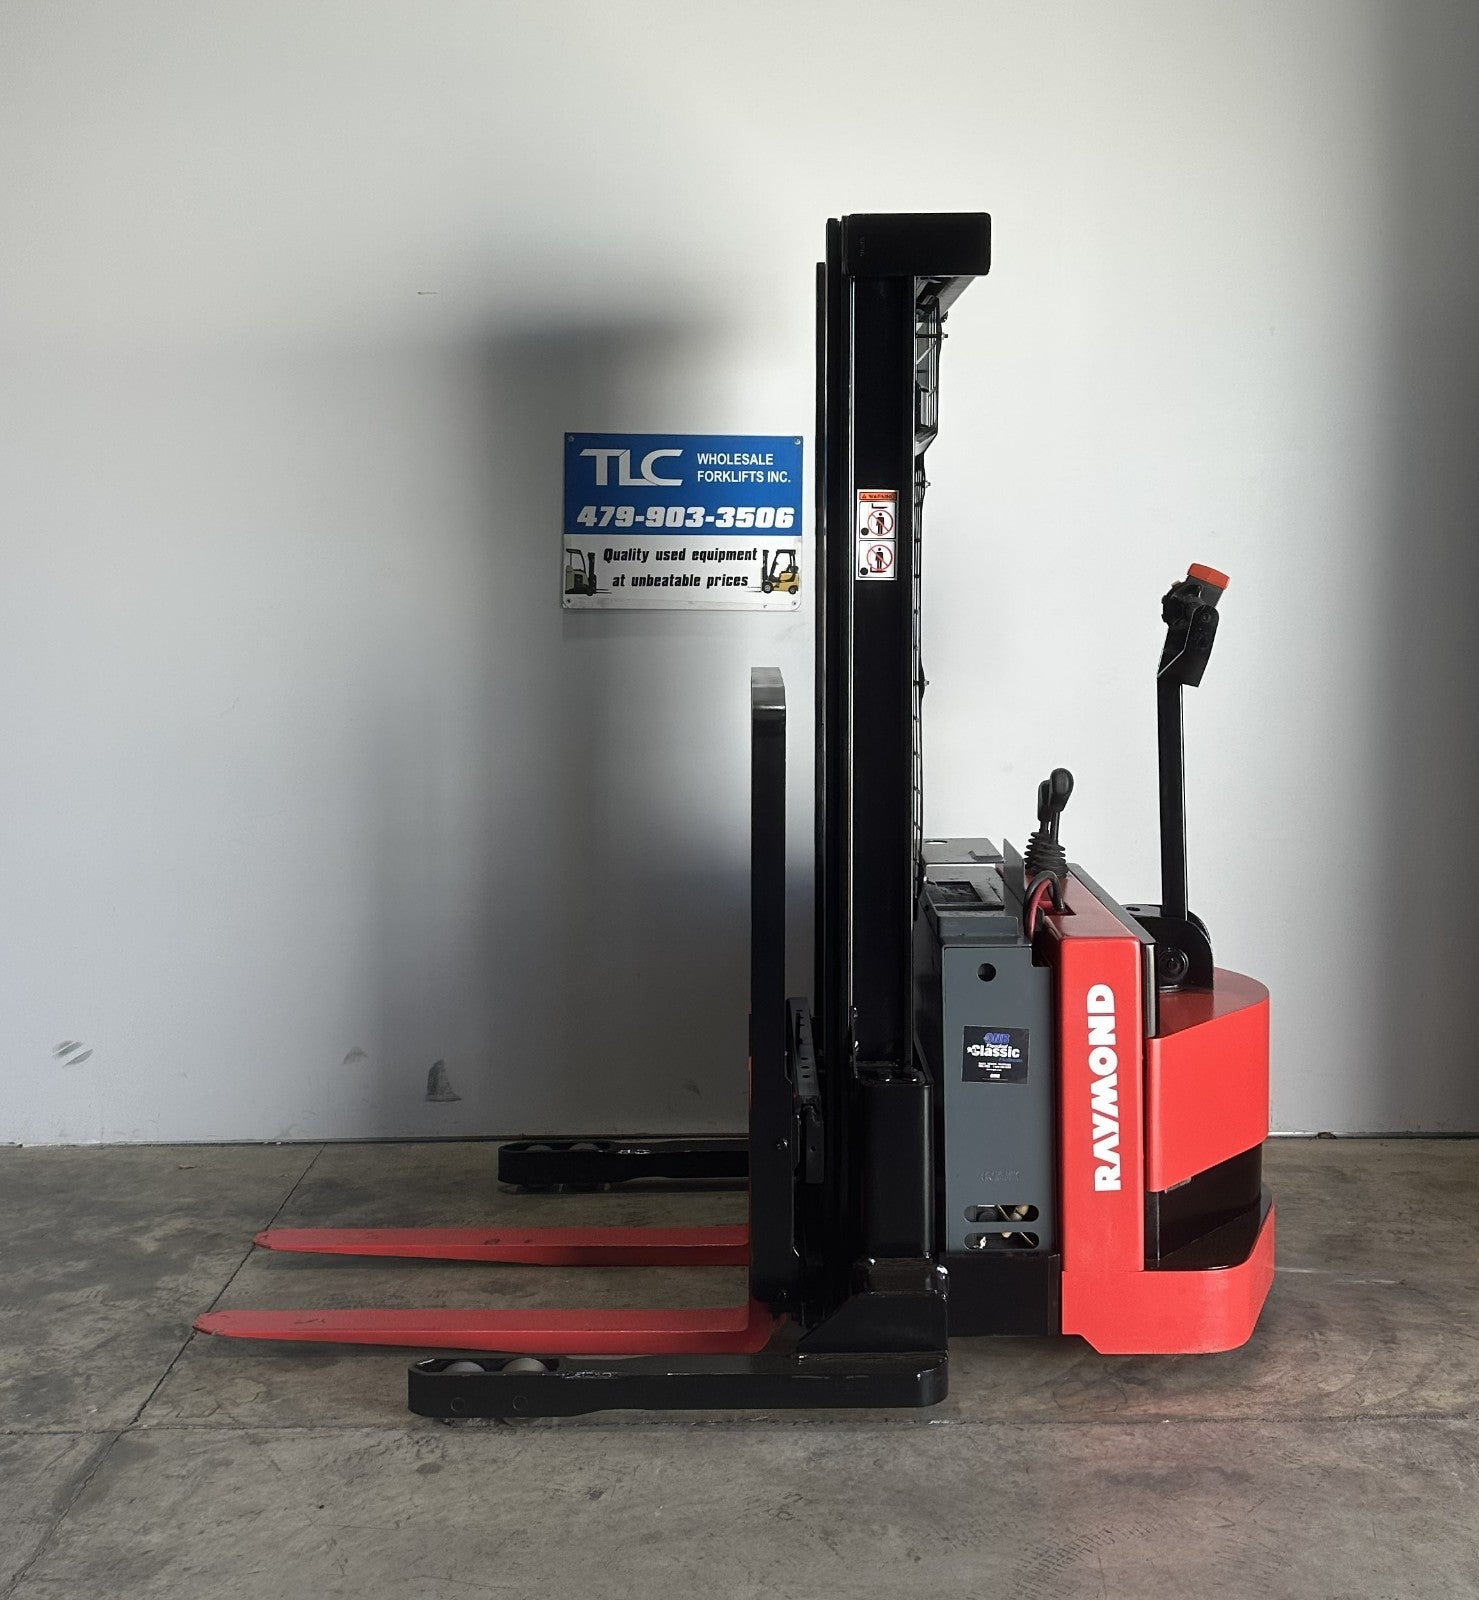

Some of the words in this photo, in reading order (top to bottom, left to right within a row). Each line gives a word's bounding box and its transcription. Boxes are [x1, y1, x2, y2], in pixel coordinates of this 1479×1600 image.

[697, 453, 774, 466] WHOLESALE
[579, 449, 684, 487] TLC
[697, 470, 764, 483] FORKLIFTS
[767, 471, 791, 483] INC.
[576, 505, 795, 528] 479-903-3506
[603, 548, 649, 563] Quality
[655, 548, 686, 561] used
[691, 548, 757, 563] equipment
[612, 575, 626, 587] at
[631, 574, 700, 587] unbeatable
[706, 574, 749, 587] prices
[971, 1044, 1021, 1058] Classic
[1086, 984, 1122, 1192] RAYMOND
